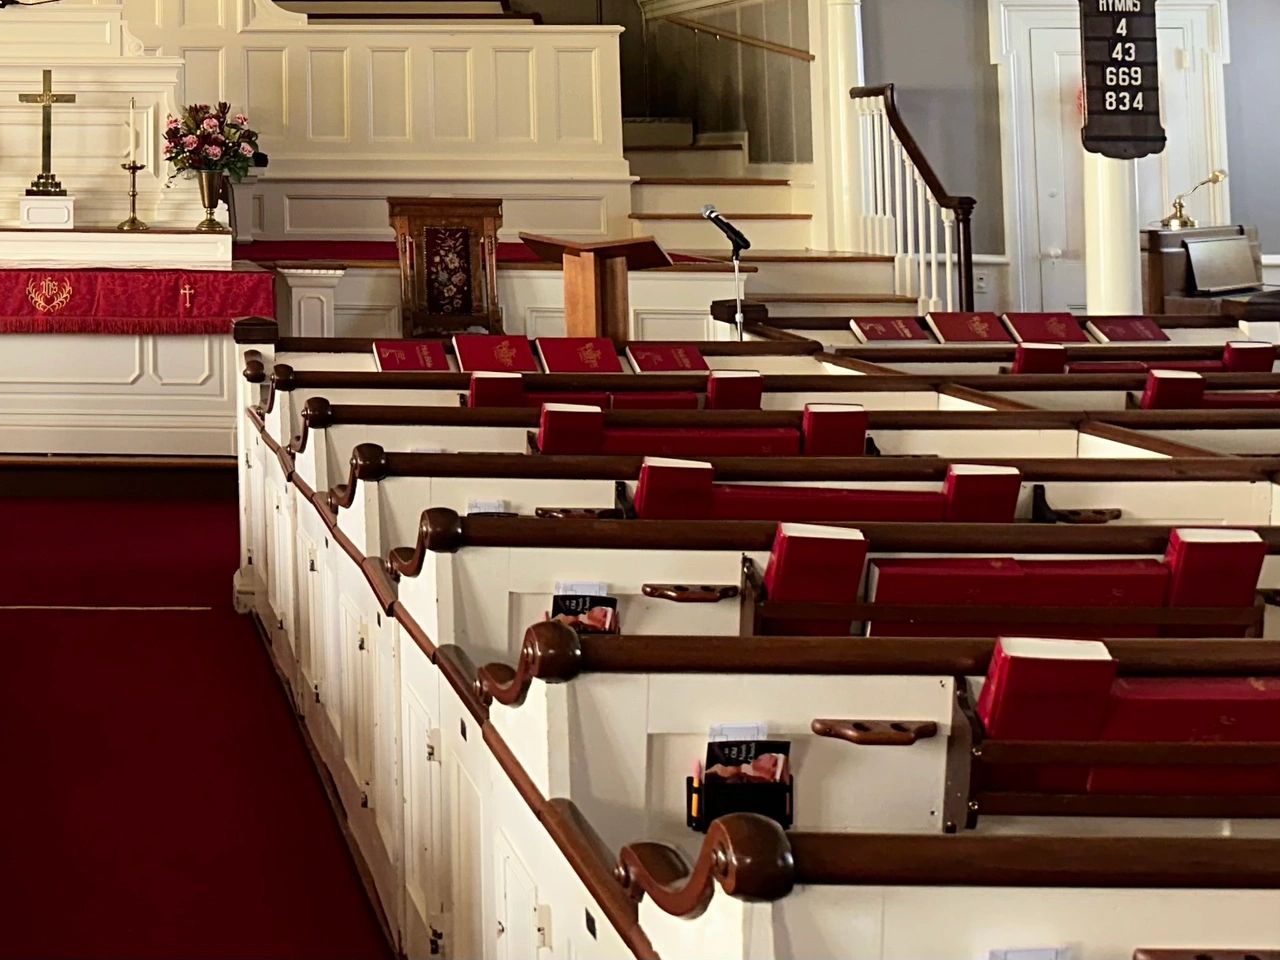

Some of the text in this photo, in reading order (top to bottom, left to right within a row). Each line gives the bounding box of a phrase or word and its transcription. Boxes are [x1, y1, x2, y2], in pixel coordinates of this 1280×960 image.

[1116, 18, 1127, 36] 4
[1112, 42, 1136, 61] 43
[1106, 67, 1142, 86] 669
[1105, 92, 1143, 111] 834
